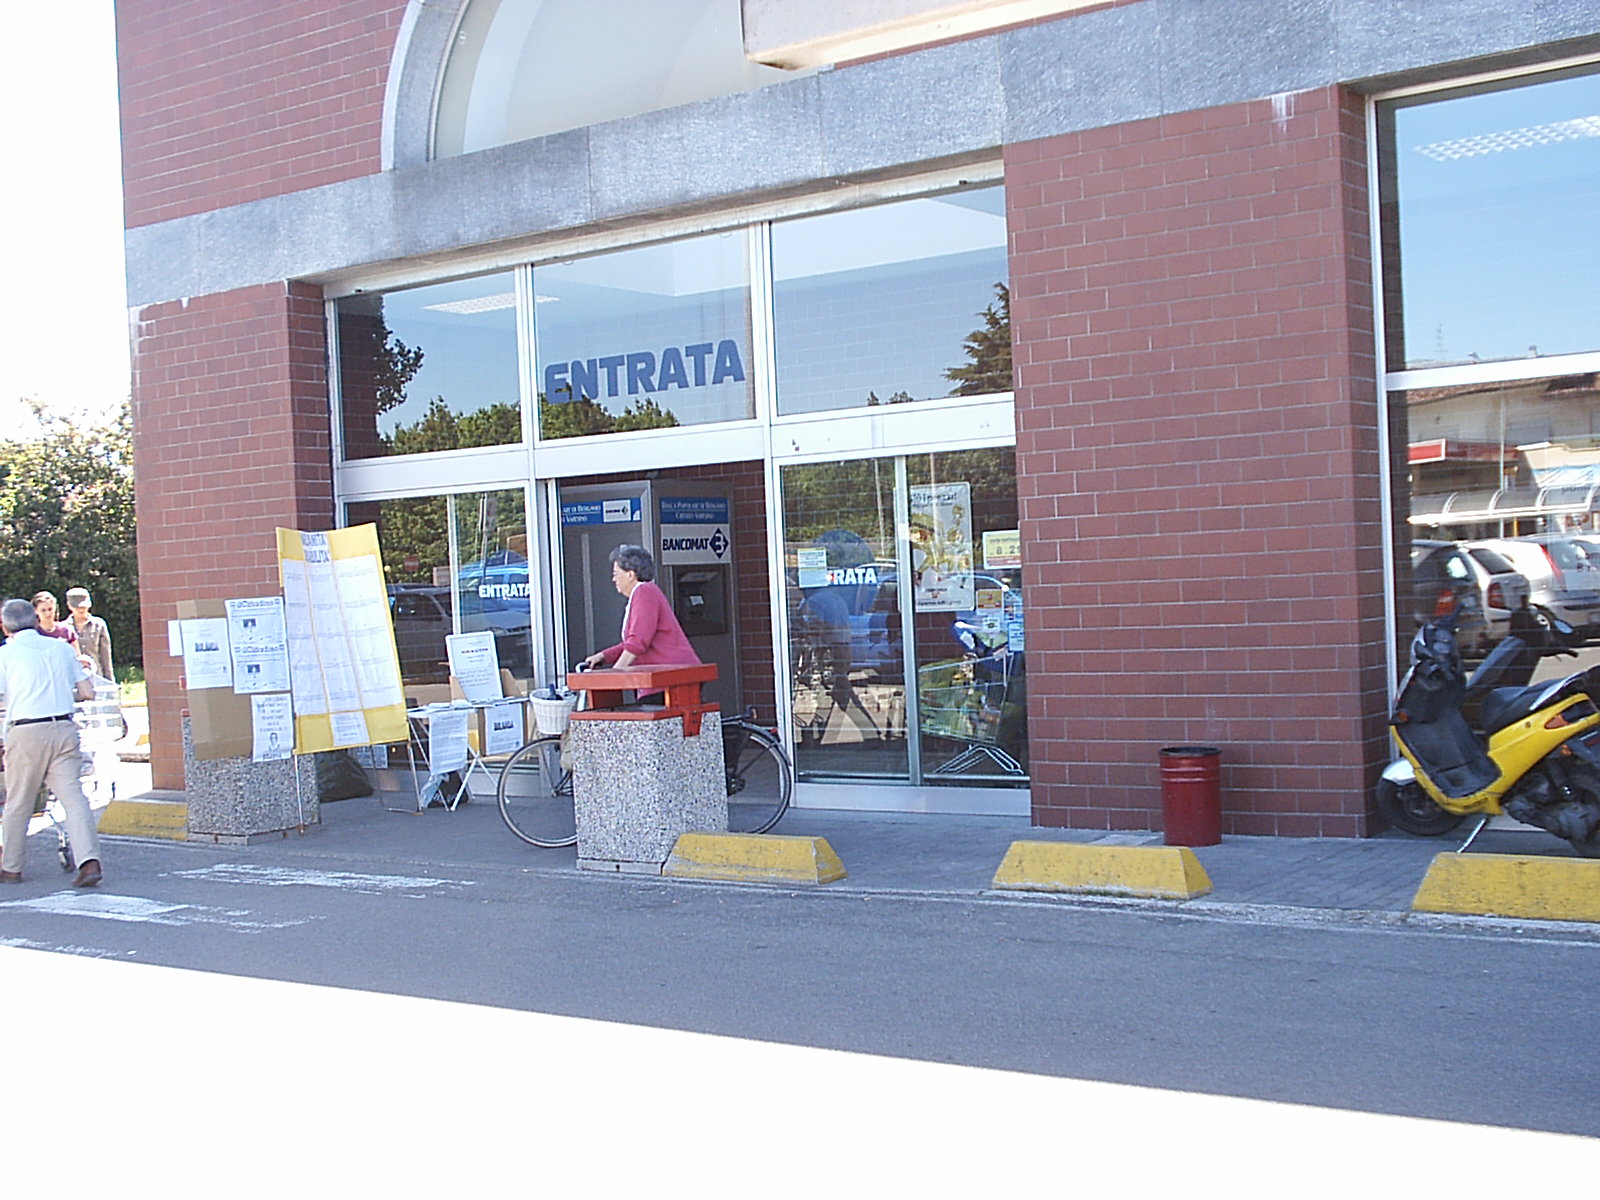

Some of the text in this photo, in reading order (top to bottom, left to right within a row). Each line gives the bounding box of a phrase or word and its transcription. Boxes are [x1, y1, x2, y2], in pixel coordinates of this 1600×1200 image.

[545, 339, 746, 404] ENTRATA
[662, 537, 709, 551] BANCOMAT
[828, 567, 877, 585] RATA
[478, 583, 530, 598] ENTRATA
